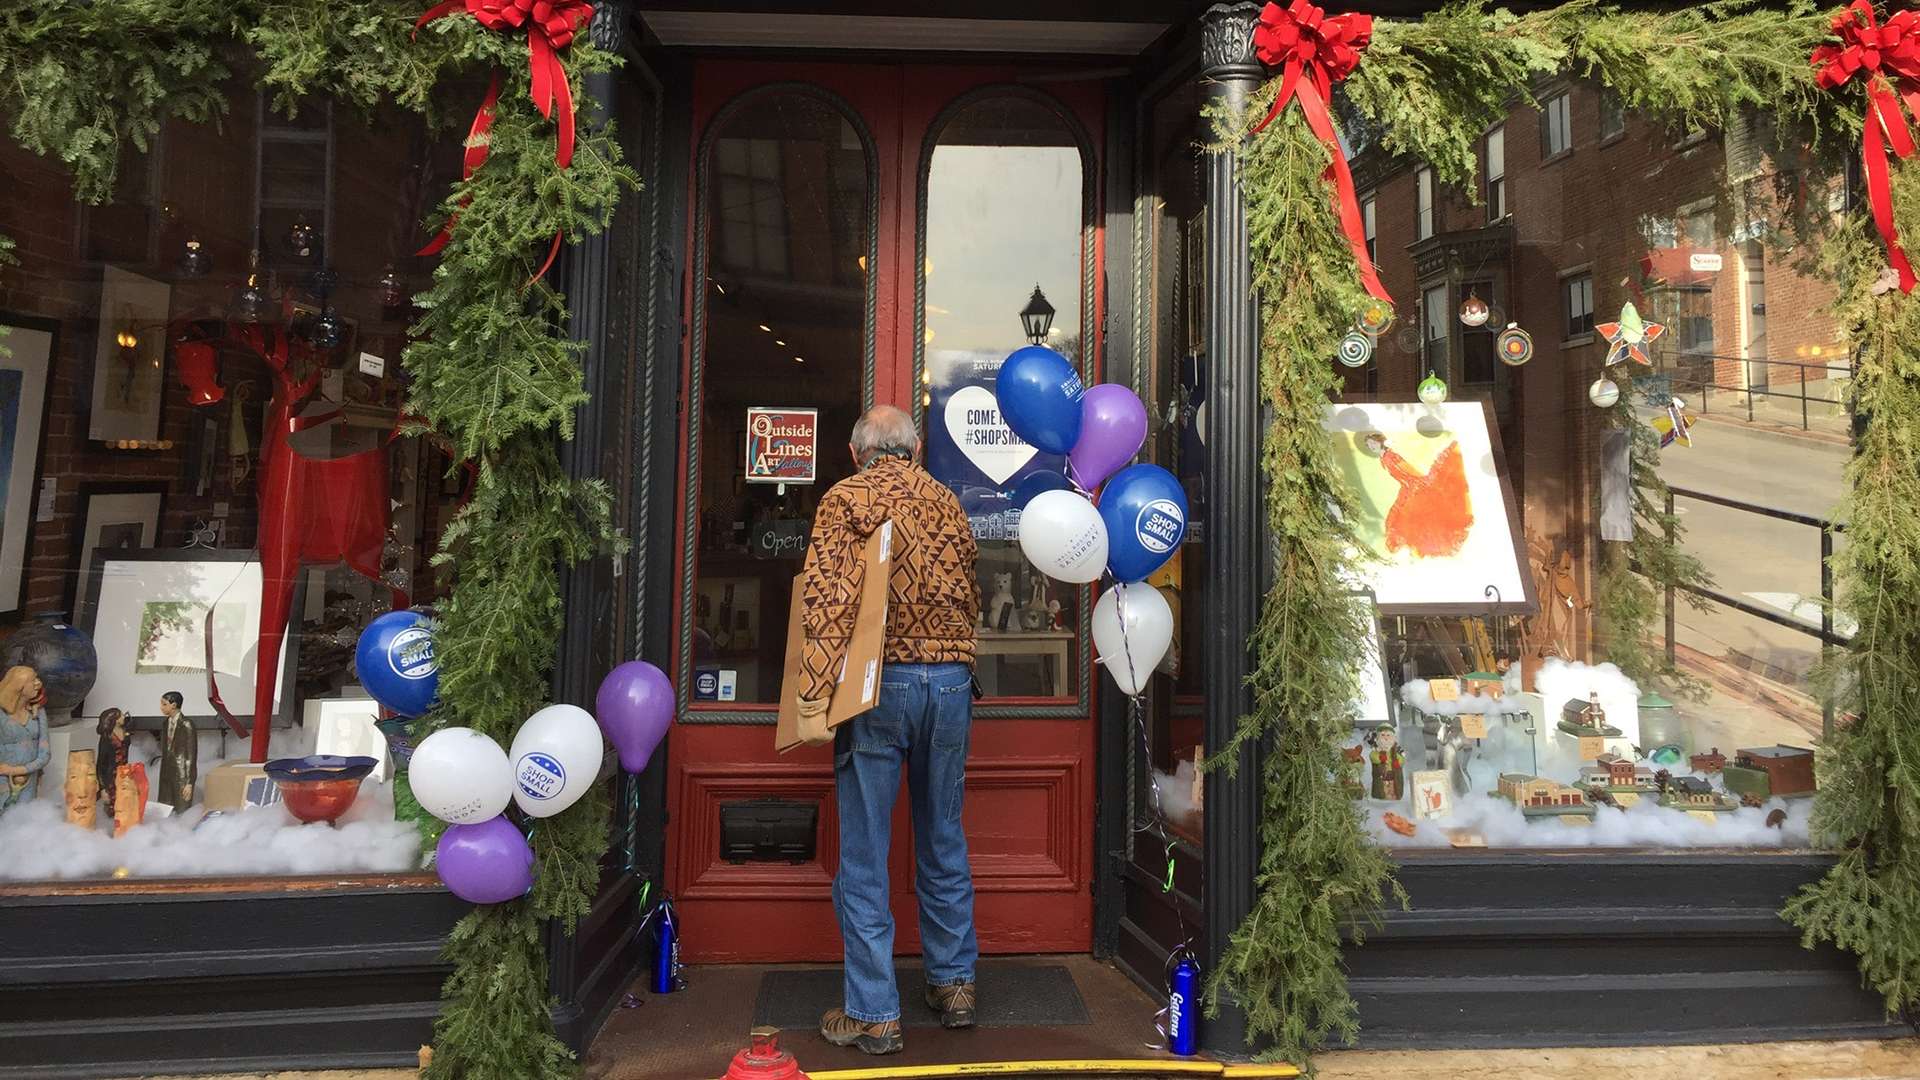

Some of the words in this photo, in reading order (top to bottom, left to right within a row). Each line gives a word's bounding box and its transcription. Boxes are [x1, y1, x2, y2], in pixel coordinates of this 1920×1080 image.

[751, 414, 813, 437] Outside
[967, 409, 996, 425] COME
[764, 435, 813, 456] Lines
[1144, 521, 1174, 543] SMALL
[1151, 513, 1178, 532] SHOP
[762, 530, 806, 557] Open
[1059, 529, 1099, 569] SATURDAY
[521, 771, 552, 794] SMALL
[526, 765, 555, 785] SHOP
[1170, 992, 1184, 1038] Galena
